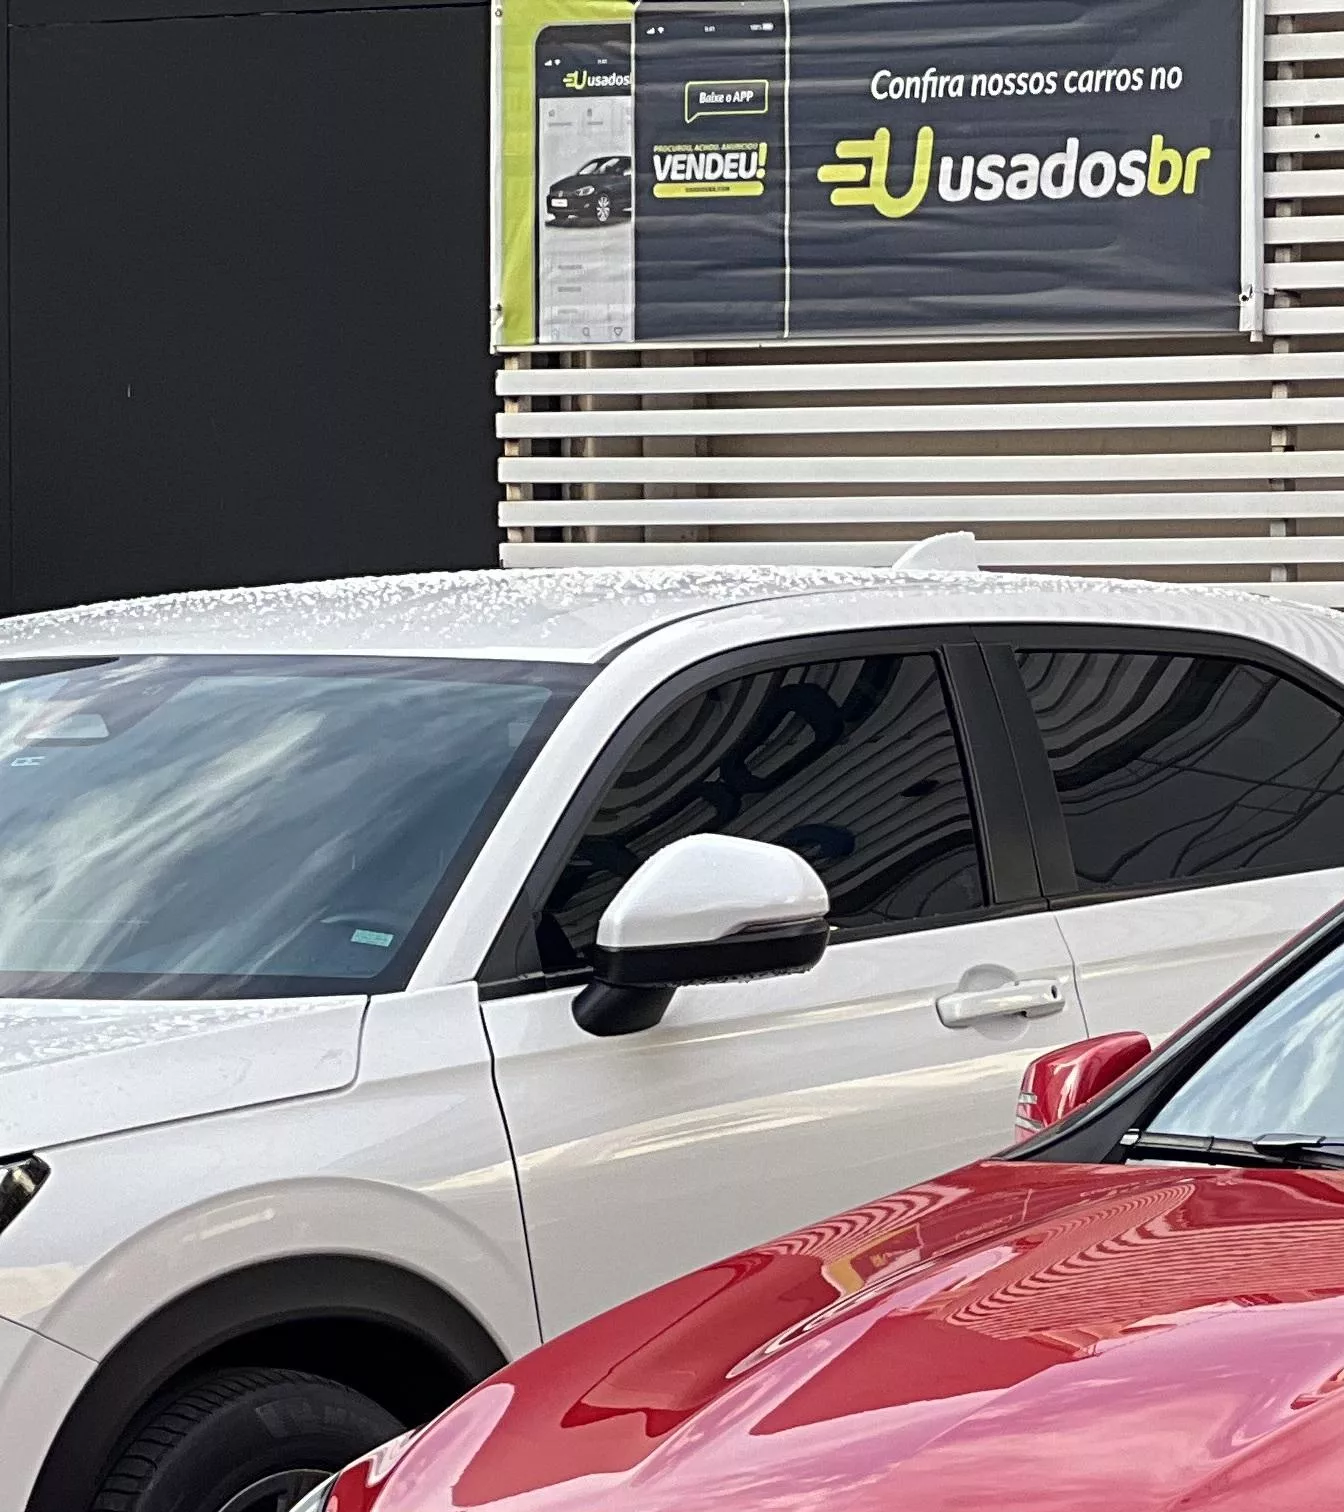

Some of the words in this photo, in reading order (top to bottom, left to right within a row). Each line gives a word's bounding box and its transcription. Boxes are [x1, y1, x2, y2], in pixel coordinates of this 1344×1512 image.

[587, 72, 633, 87] usados
[732, 90, 754, 103] APP
[870, 67, 964, 103] Confira
[970, 69, 1058, 97] nossos
[1063, 67, 1144, 94] carros
[1150, 65, 1183, 90] no
[653, 142, 768, 182] VENDEU!
[938, 134, 1211, 202] usadosbr
